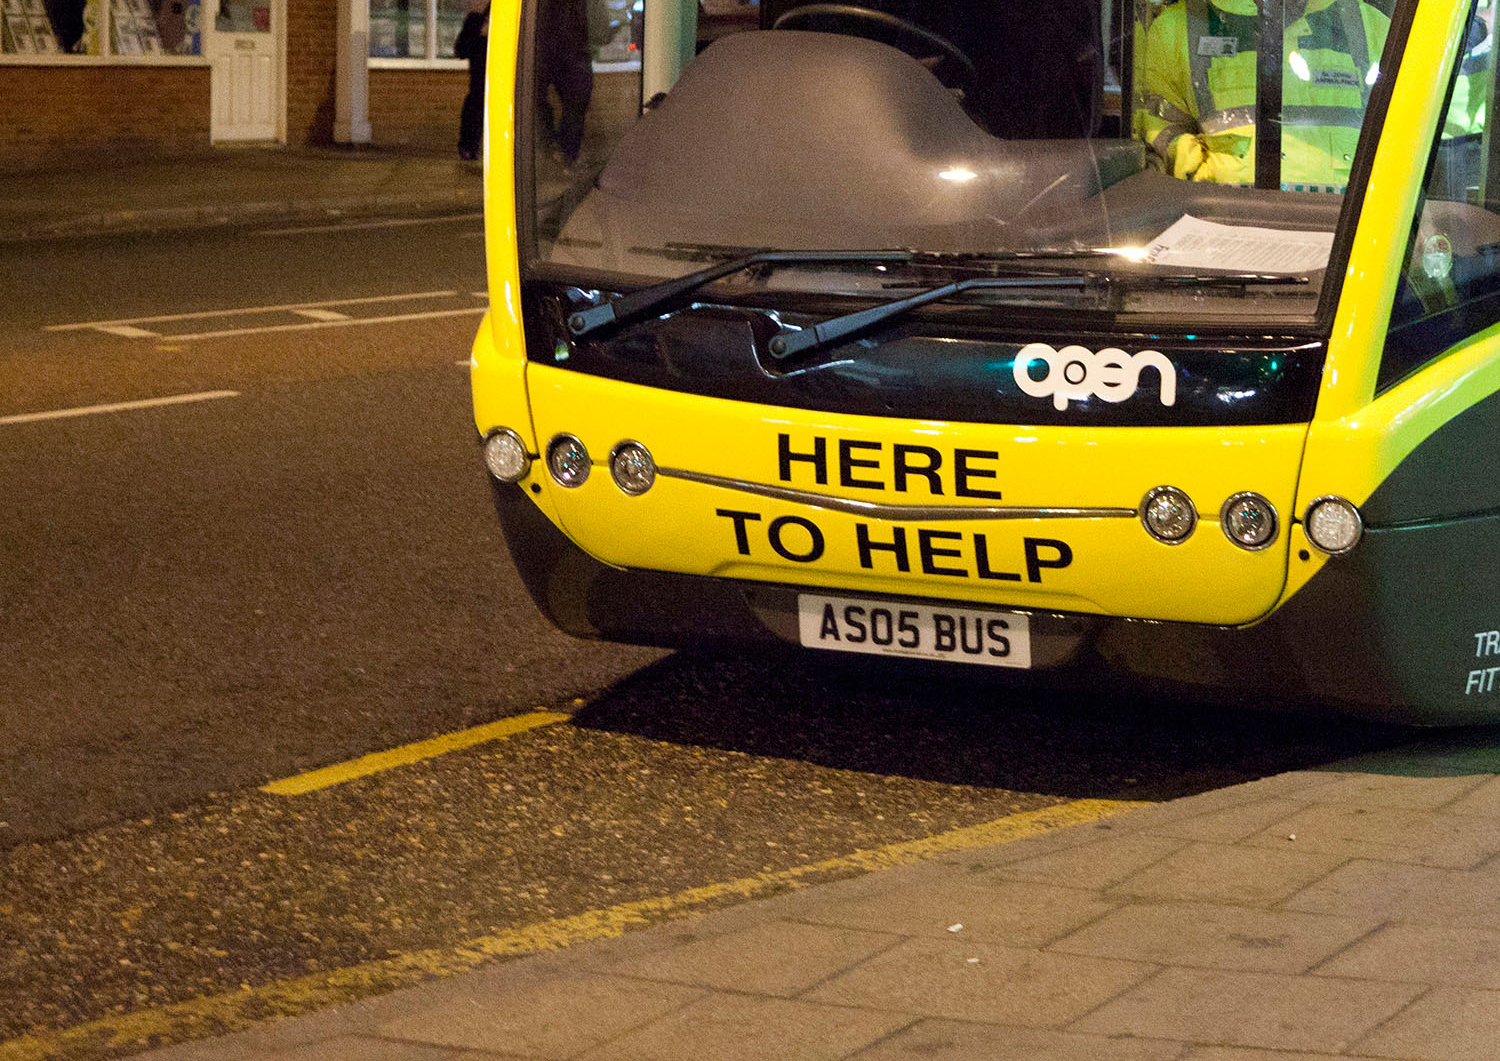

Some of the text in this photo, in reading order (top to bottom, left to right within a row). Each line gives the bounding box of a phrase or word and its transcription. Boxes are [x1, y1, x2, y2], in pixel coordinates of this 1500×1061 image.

[1013, 343, 1177, 411] open
[777, 433, 1002, 500] HERE
[716, 508, 1074, 584] TO HELP
[819, 602, 1012, 658] AS05 BUS
